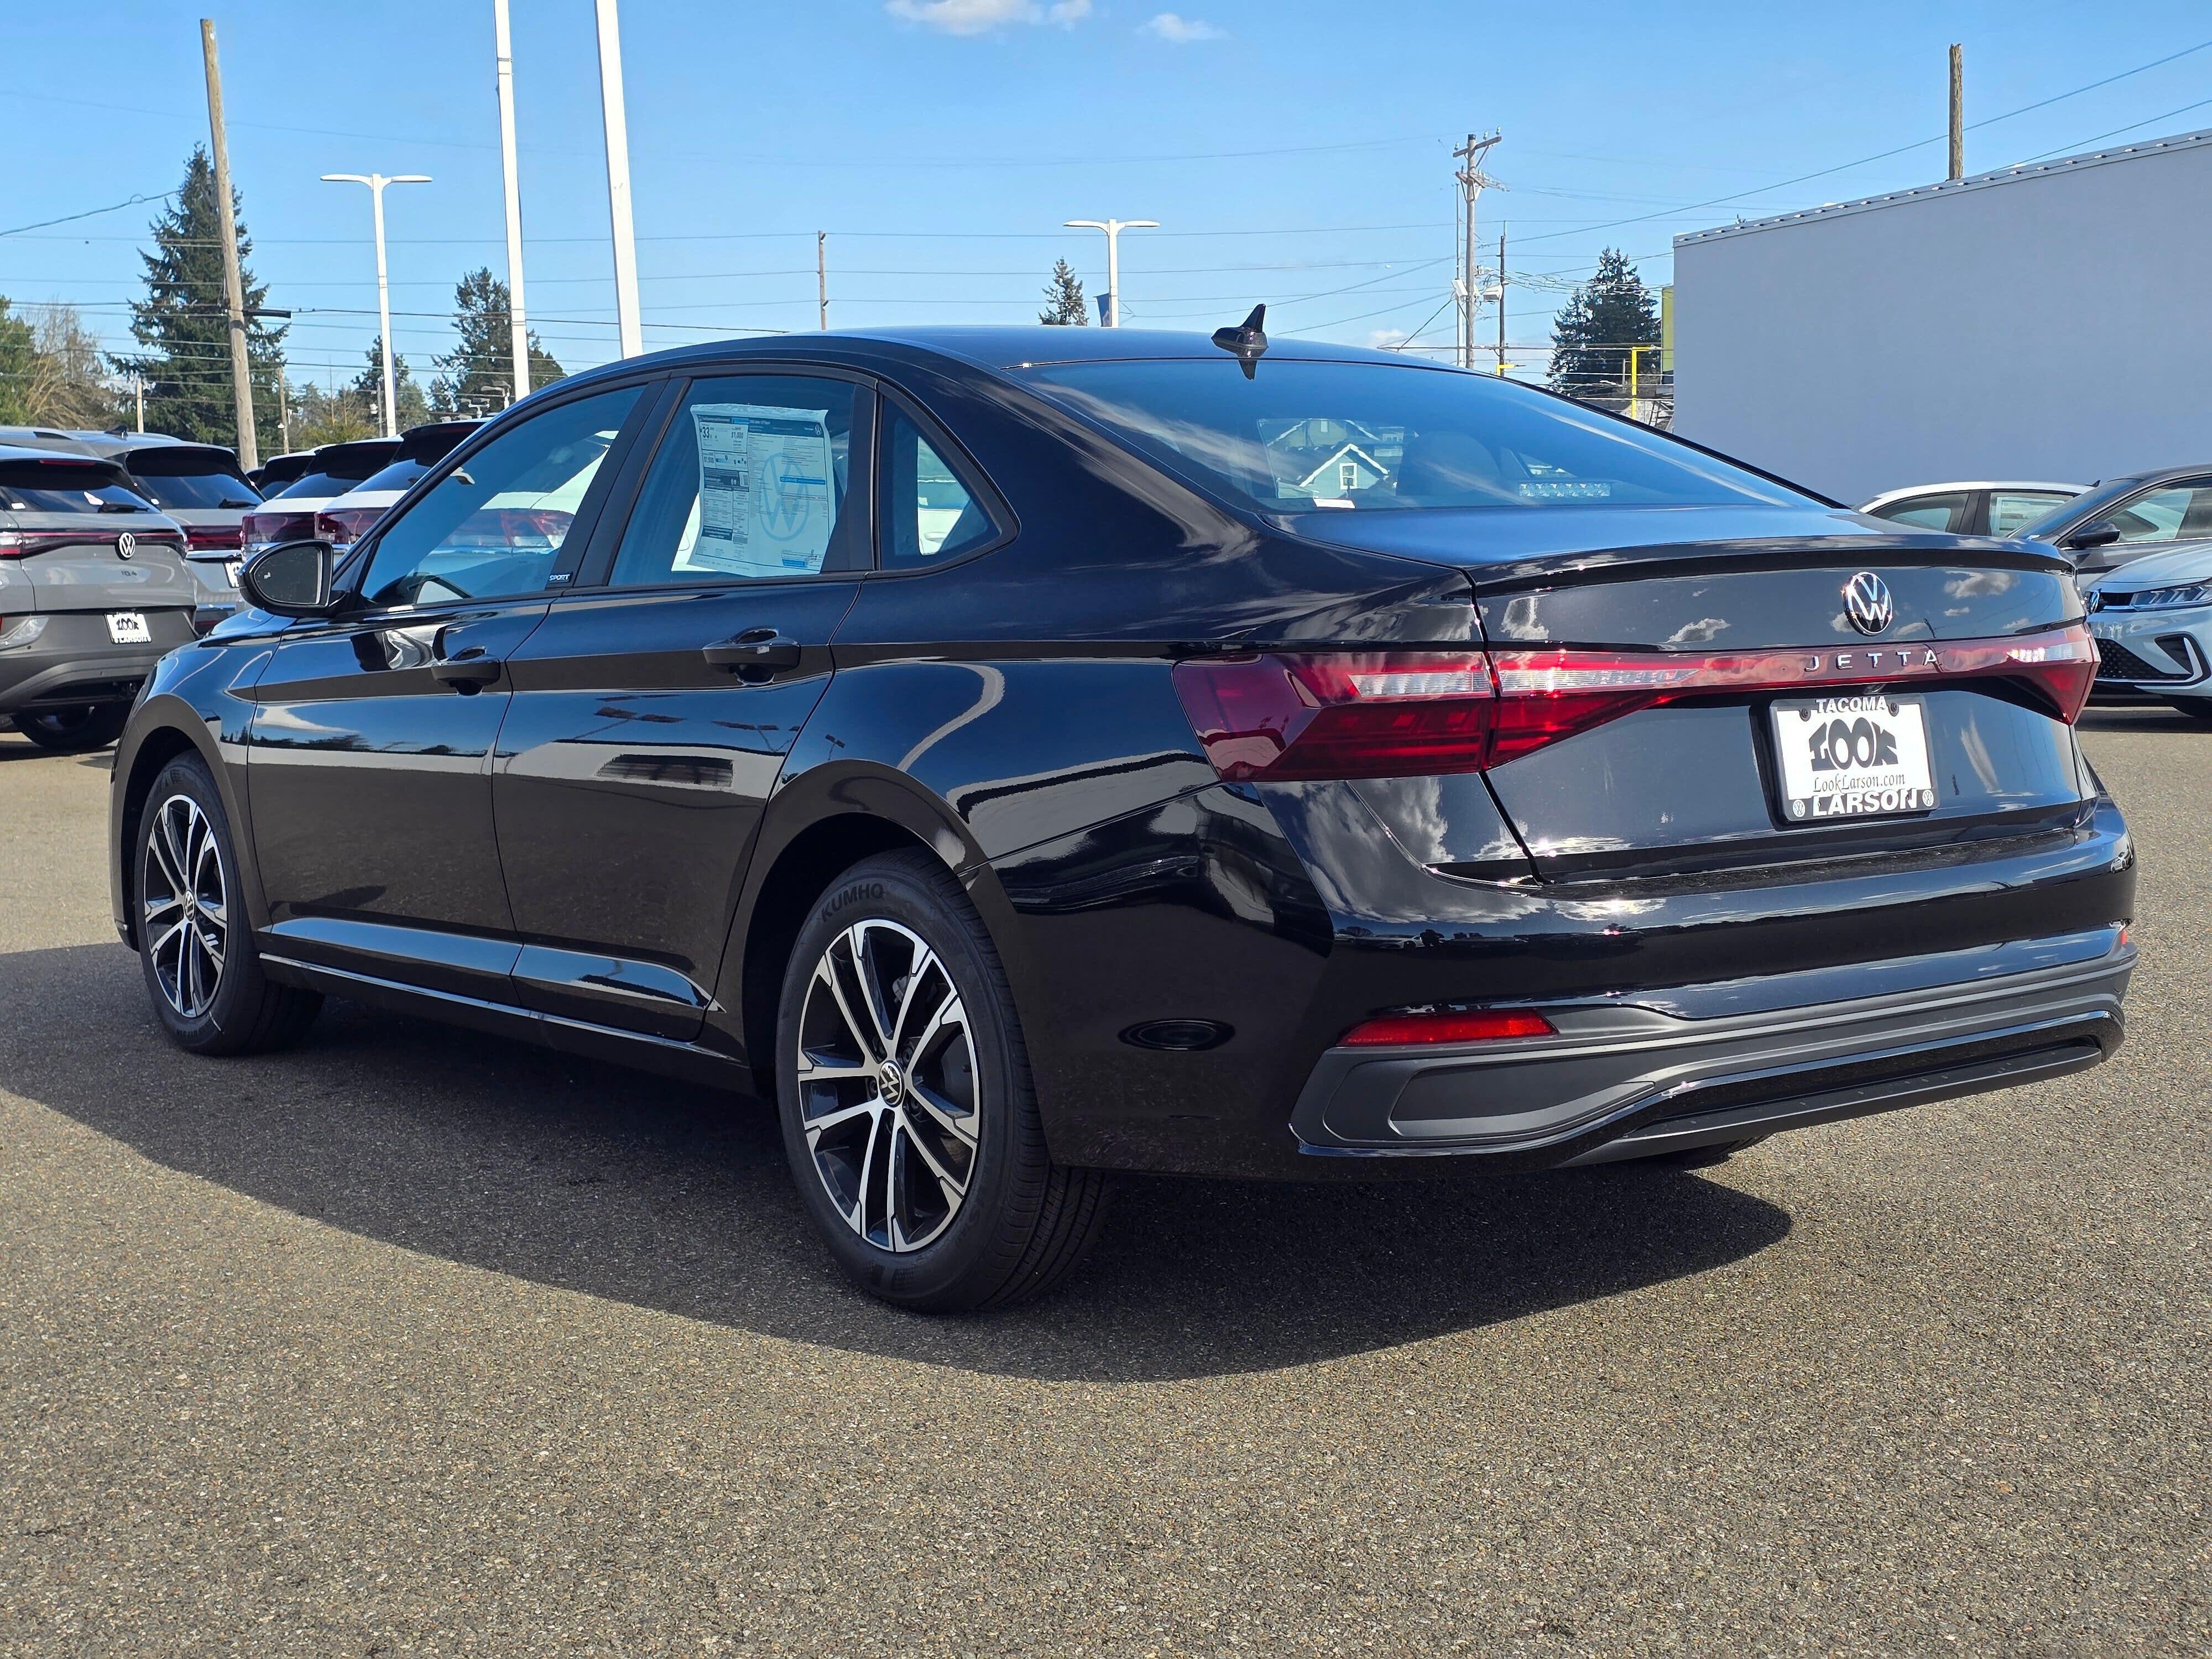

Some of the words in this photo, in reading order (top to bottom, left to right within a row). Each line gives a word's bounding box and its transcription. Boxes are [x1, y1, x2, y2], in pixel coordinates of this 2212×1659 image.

[702, 426, 709, 438] 33
[1804, 649, 1940, 672] JETTA
[1815, 696, 1887, 713] TACOMA
[1808, 717, 1899, 771] LOOK
[1813, 773, 1906, 792] LookLarson.com
[1813, 788, 1917, 817] LARSON
[821, 883, 884, 923] KUMHO
